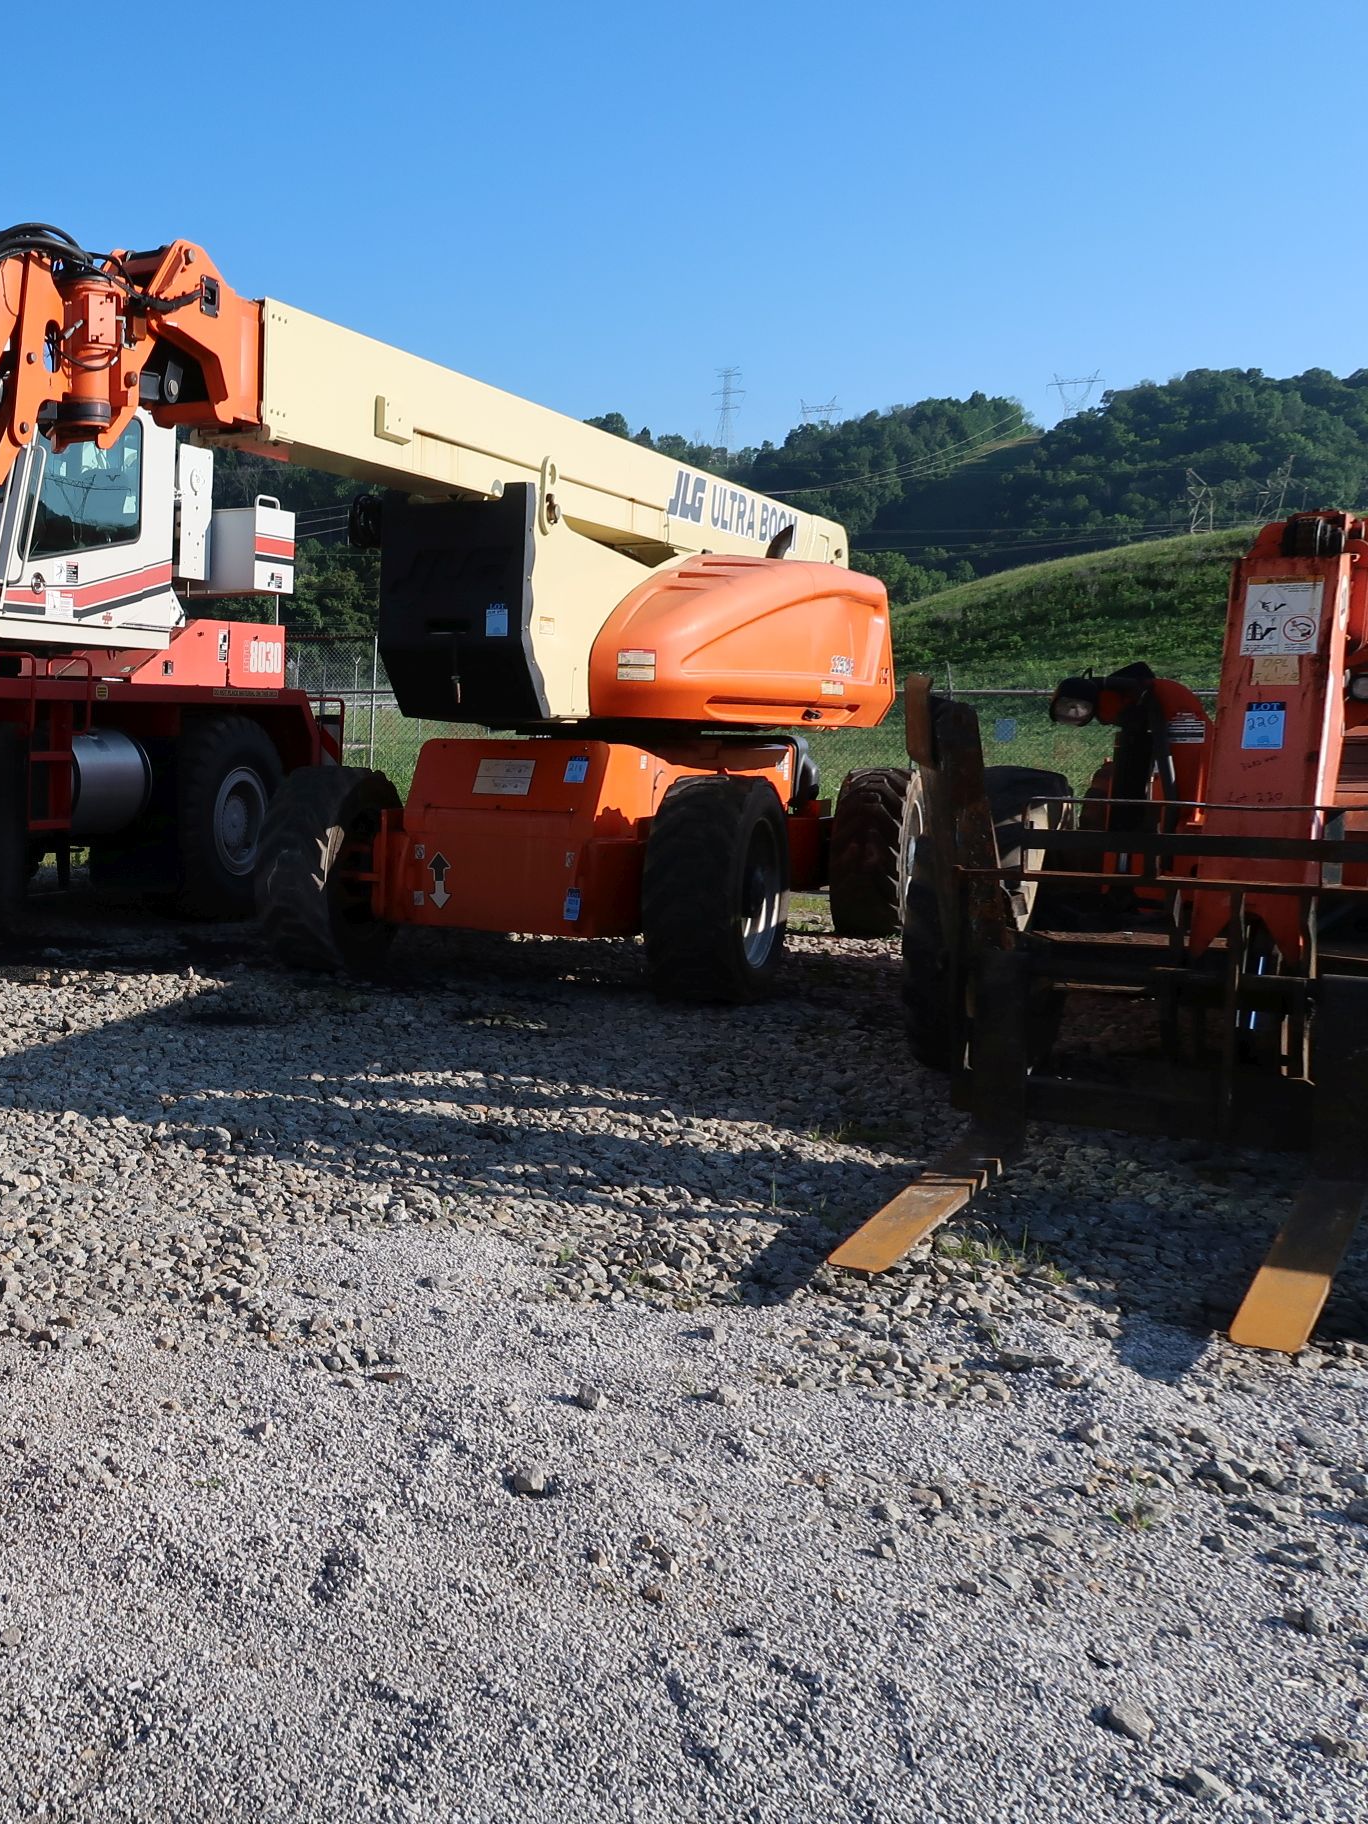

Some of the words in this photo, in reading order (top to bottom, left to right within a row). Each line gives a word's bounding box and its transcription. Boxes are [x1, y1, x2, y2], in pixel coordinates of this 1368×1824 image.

[668, 469, 707, 524] JLG
[711, 484, 755, 539] ULTRA
[250, 641, 281, 673] 8030
[1252, 702, 1281, 712] LOT
[1247, 714, 1280, 731] 220
